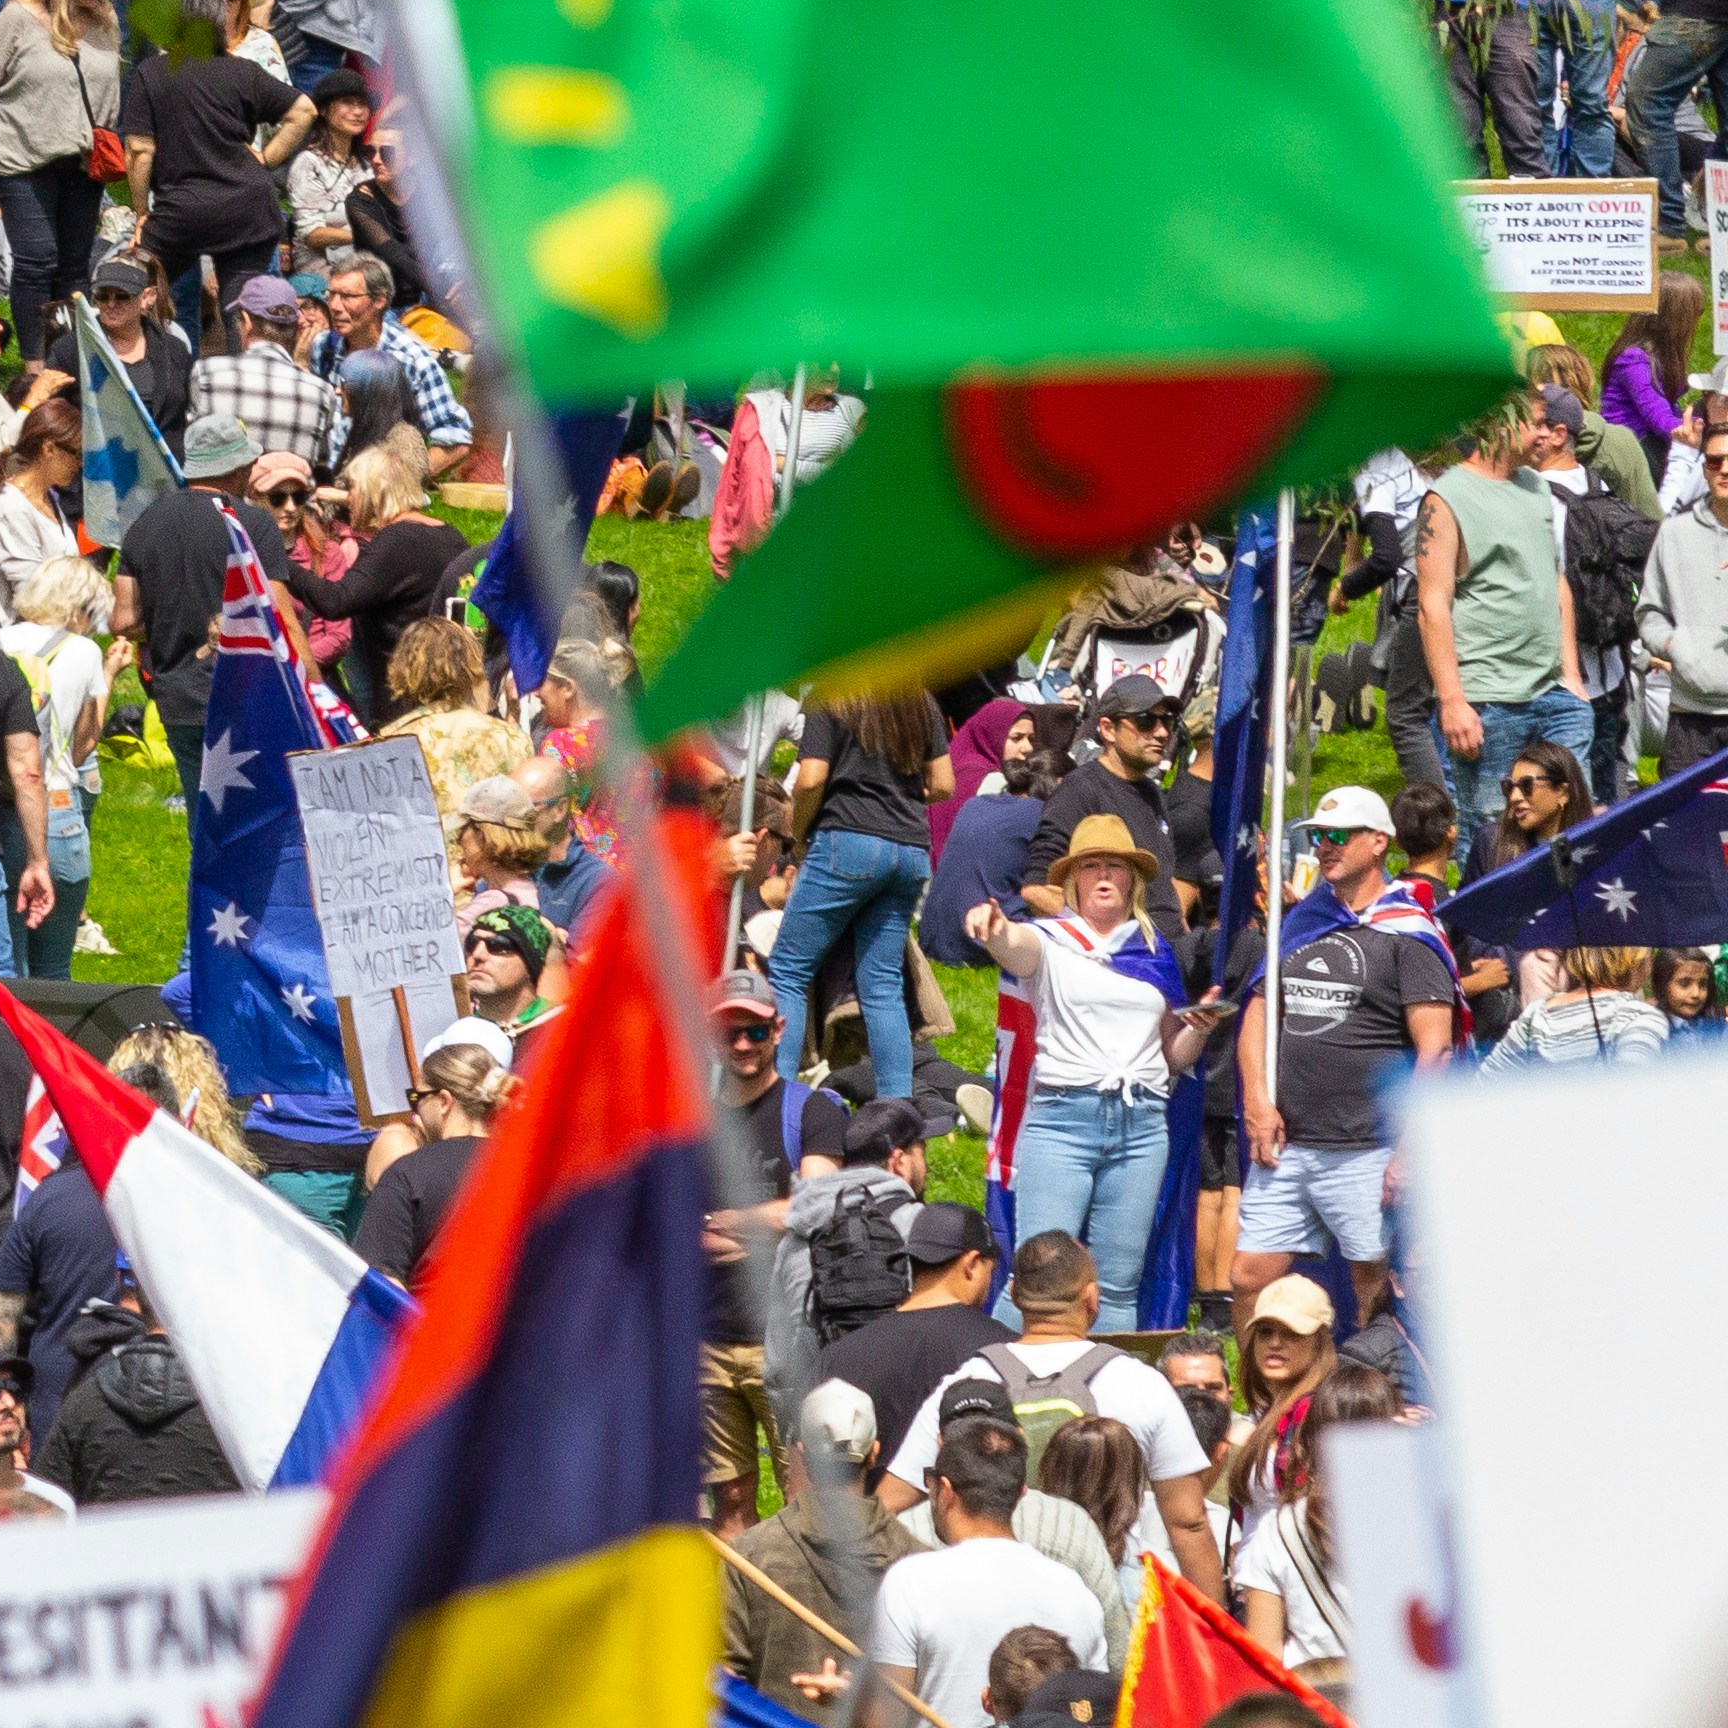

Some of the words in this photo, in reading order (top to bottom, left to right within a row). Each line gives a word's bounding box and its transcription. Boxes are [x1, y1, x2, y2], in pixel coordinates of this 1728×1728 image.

[1503, 202, 1532, 212] NOT
[1537, 202, 1583, 213] ABOUT
[1506, 217, 1529, 228] ITS
[1534, 218, 1581, 228] ABOUT
[1584, 218, 1644, 228] KEEPING
[1497, 233, 1544, 243] THOSE
[1547, 233, 1584, 243] ANTS
[1587, 233, 1602, 243] IN
[1572, 257, 1600, 267] NOT
[319, 766, 354, 811] AM
[358, 757, 403, 808] NOT
[409, 756, 430, 800] A
[376, 897, 454, 937] CONCERNED
[352, 940, 444, 986] MOTHER
